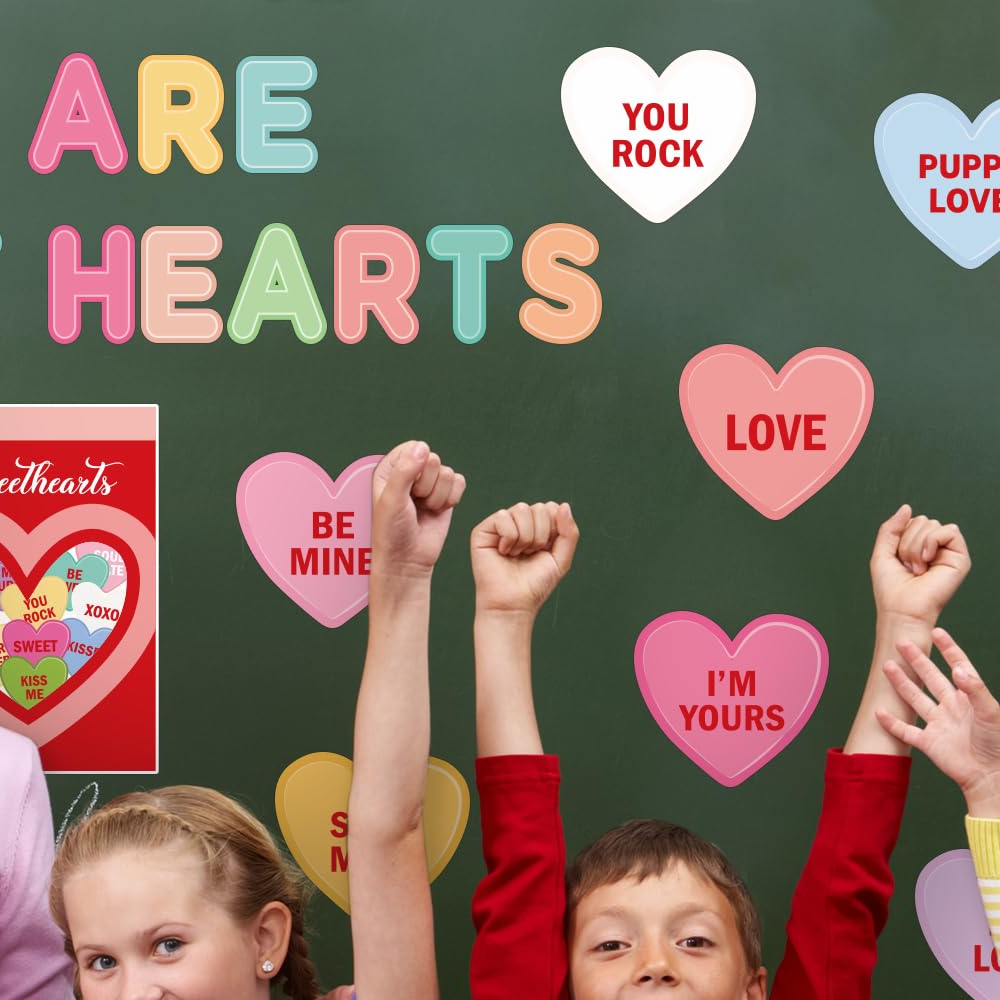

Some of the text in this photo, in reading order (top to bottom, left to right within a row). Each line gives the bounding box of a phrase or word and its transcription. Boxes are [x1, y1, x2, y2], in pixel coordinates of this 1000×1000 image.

[28, 53, 318, 174] ARE
[624, 103, 689, 131] YOU
[612, 139, 704, 168] ROCK
[919, 154, 1000, 179] PUPP
[48, 223, 602, 344] HEARTS
[726, 414, 827, 450] LOVE
[312, 511, 355, 539] BE
[67, 568, 83, 580] BE
[290, 547, 372, 576] MINE
[23, 595, 48, 611] YOU
[23, 607, 56, 623] ROCK
[84, 603, 120, 622] XOXO
[13, 639, 58, 653] SWEET
[20, 675, 48, 687] KISS
[26, 689, 45, 700] ME
[707, 670, 757, 697] I'M
[678, 704, 785, 732] YOURS
